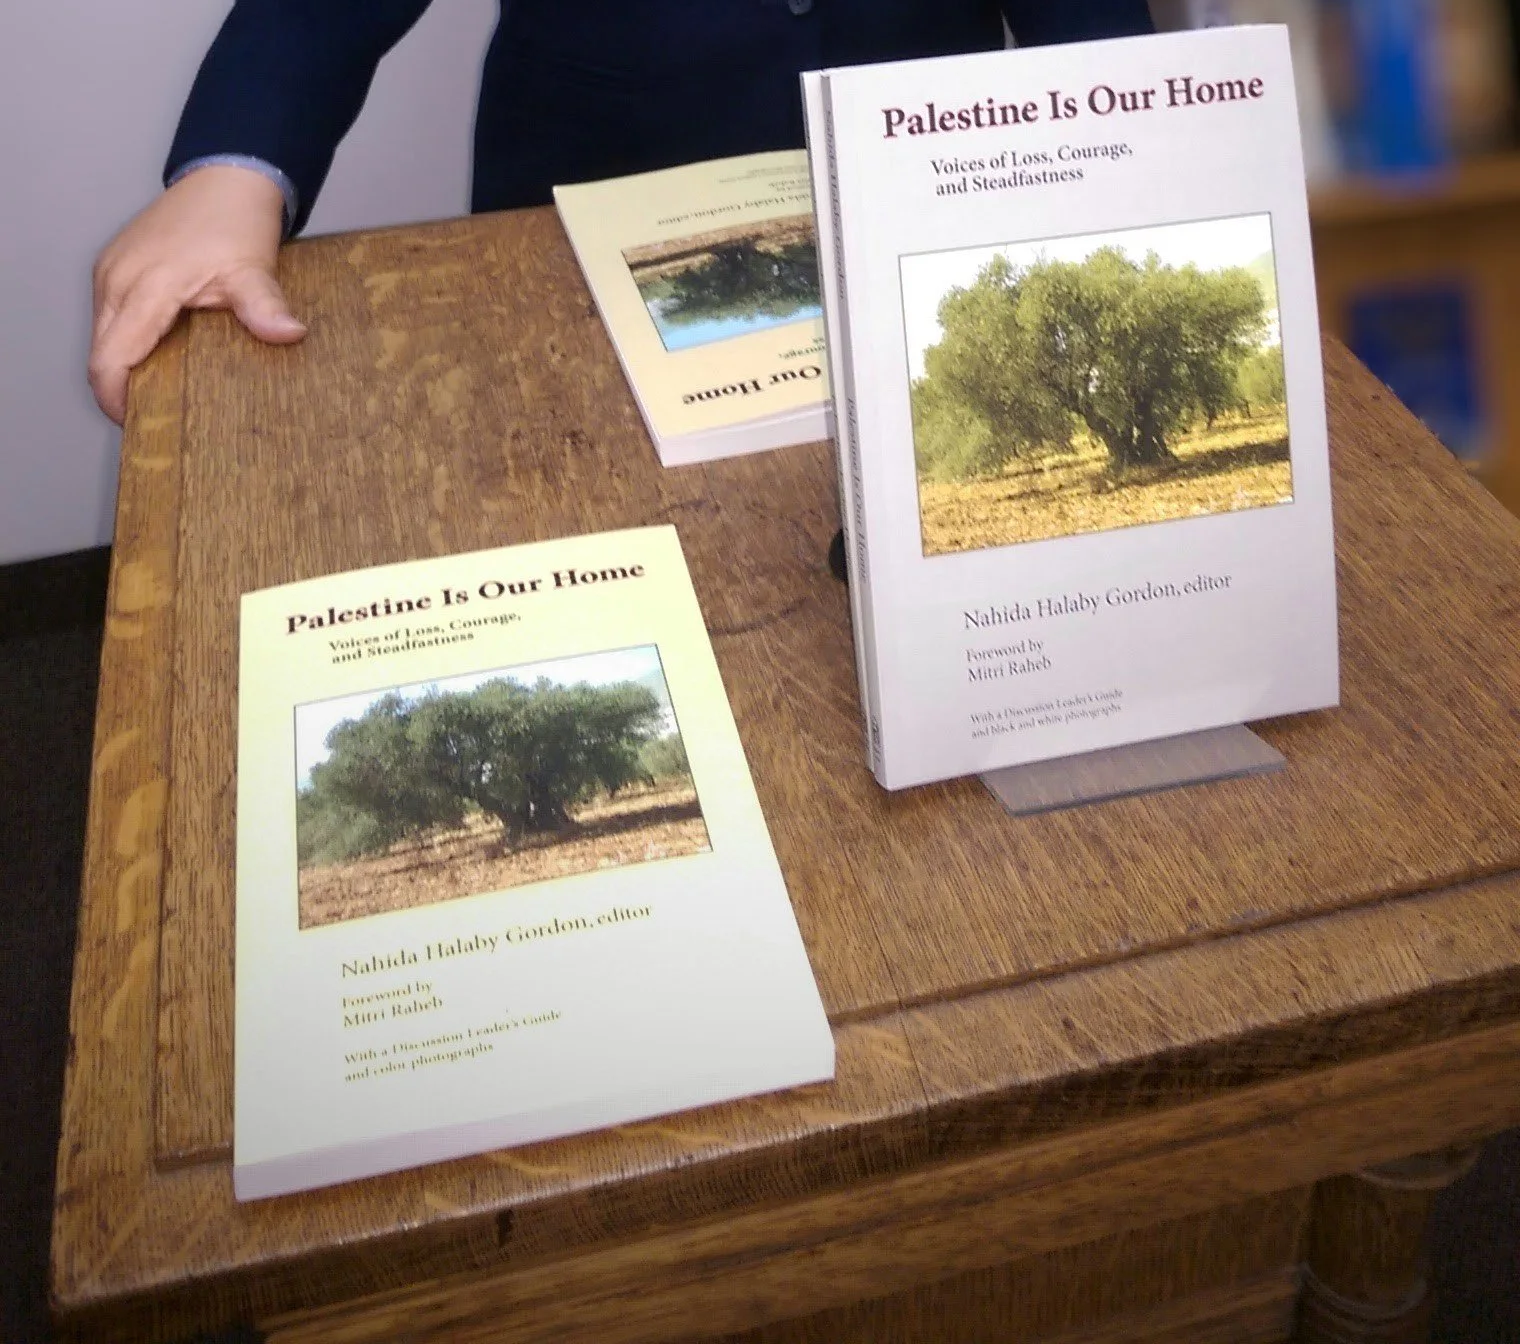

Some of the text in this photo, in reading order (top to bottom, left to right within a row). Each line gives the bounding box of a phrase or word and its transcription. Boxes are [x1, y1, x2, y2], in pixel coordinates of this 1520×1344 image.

[881, 75, 1264, 139] Palestine Is Our Home
[931, 141, 1133, 176] Voices of Loss, Courage,
[936, 167, 1084, 196] and Steadfastness
[682, 364, 822, 405] Our Home
[848, 397, 861, 469] Palestine
[286, 563, 645, 634] Palestine Is Our Home
[964, 574, 1232, 630] Nahida Halaby Gordon, editor
[329, 612, 522, 652] Voices of Loss, Courage,
[332, 632, 474, 664] and Steadfastness
[965, 638, 1044, 662] Foreword by
[968, 656, 1051, 683] Mitri Raheb
[970, 711, 995, 724] With
[971, 727, 989, 739] and
[1018, 718, 1036, 731] and
[1037, 713, 1063, 727] white
[341, 904, 652, 978] Nahida Halaby Gordon, editor
[342, 981, 433, 1008] Foreword by
[343, 996, 443, 1029] Mitri Raheb
[344, 1049, 377, 1065] With
[392, 1032, 463, 1054] Discussion
[522, 1009, 562, 1027] Guide
[344, 1042, 494, 1083] and color photographs
